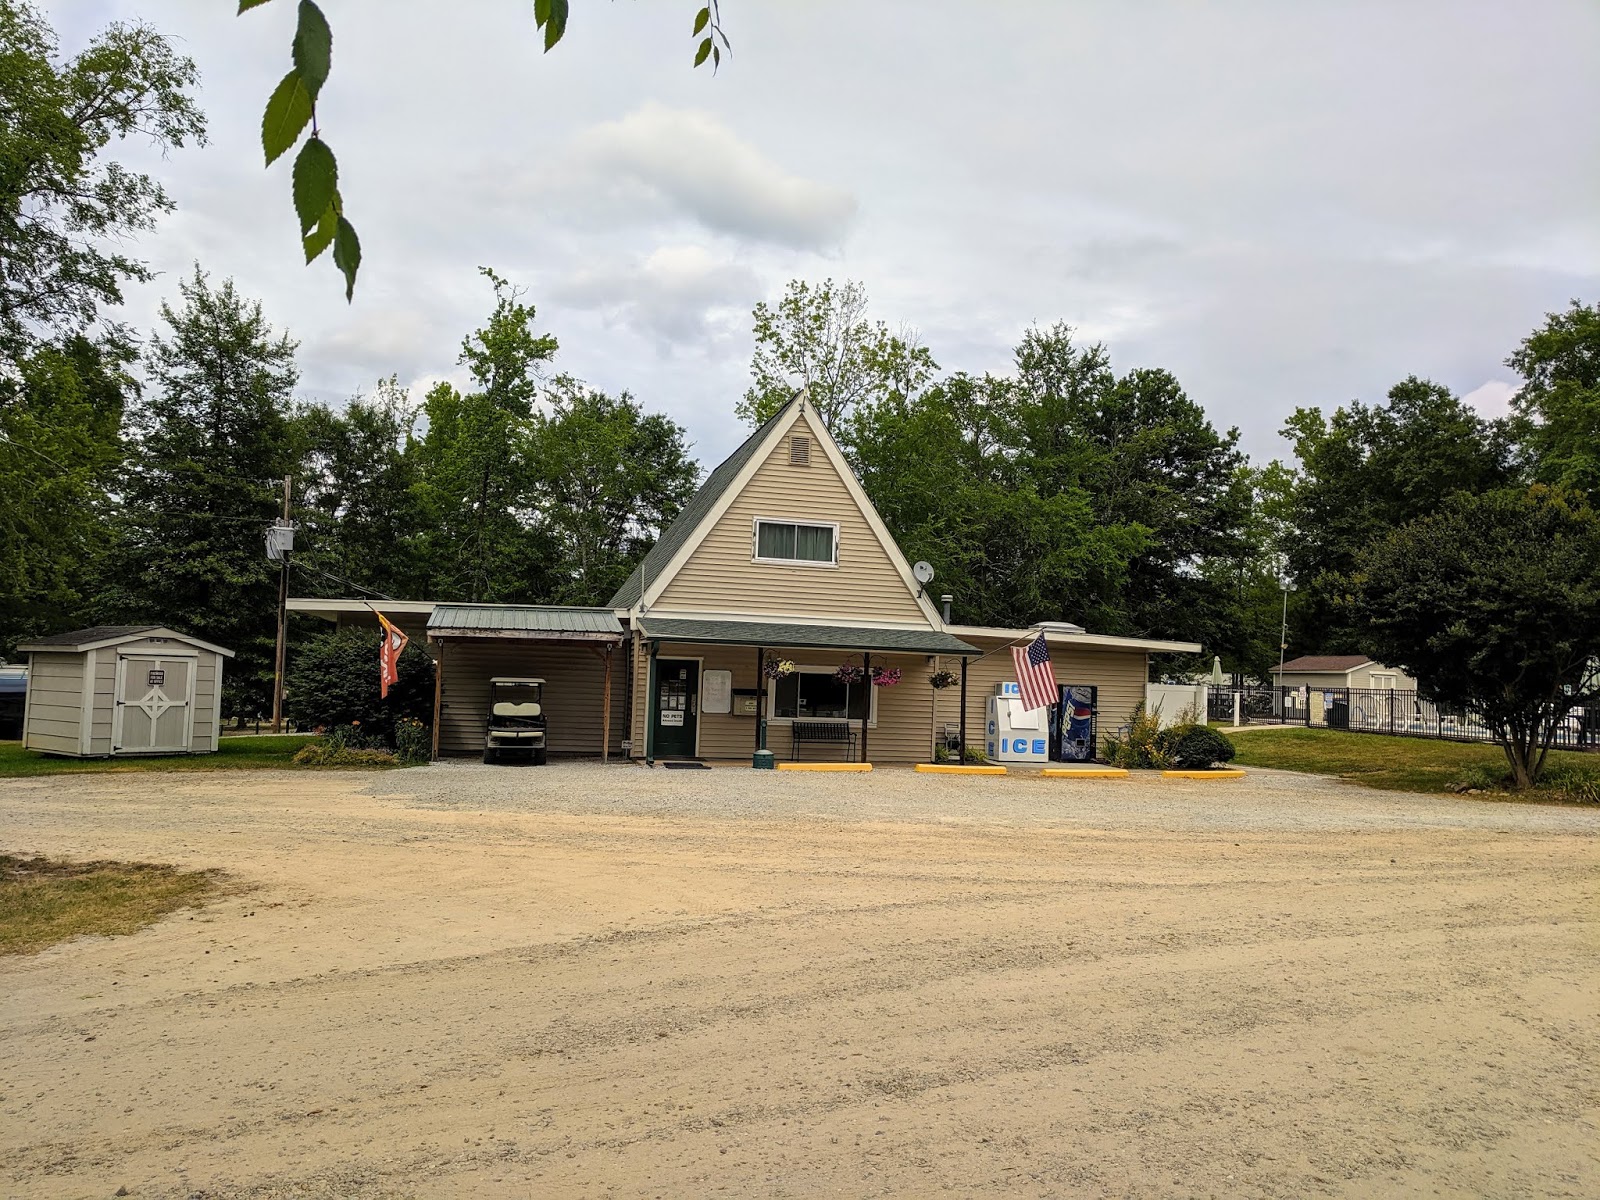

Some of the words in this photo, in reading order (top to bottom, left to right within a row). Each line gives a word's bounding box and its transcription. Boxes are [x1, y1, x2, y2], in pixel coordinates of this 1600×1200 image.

[1004, 684, 1019, 693] IC
[1062, 701, 1076, 737] PEPSI
[1002, 738, 1046, 755] ICE
